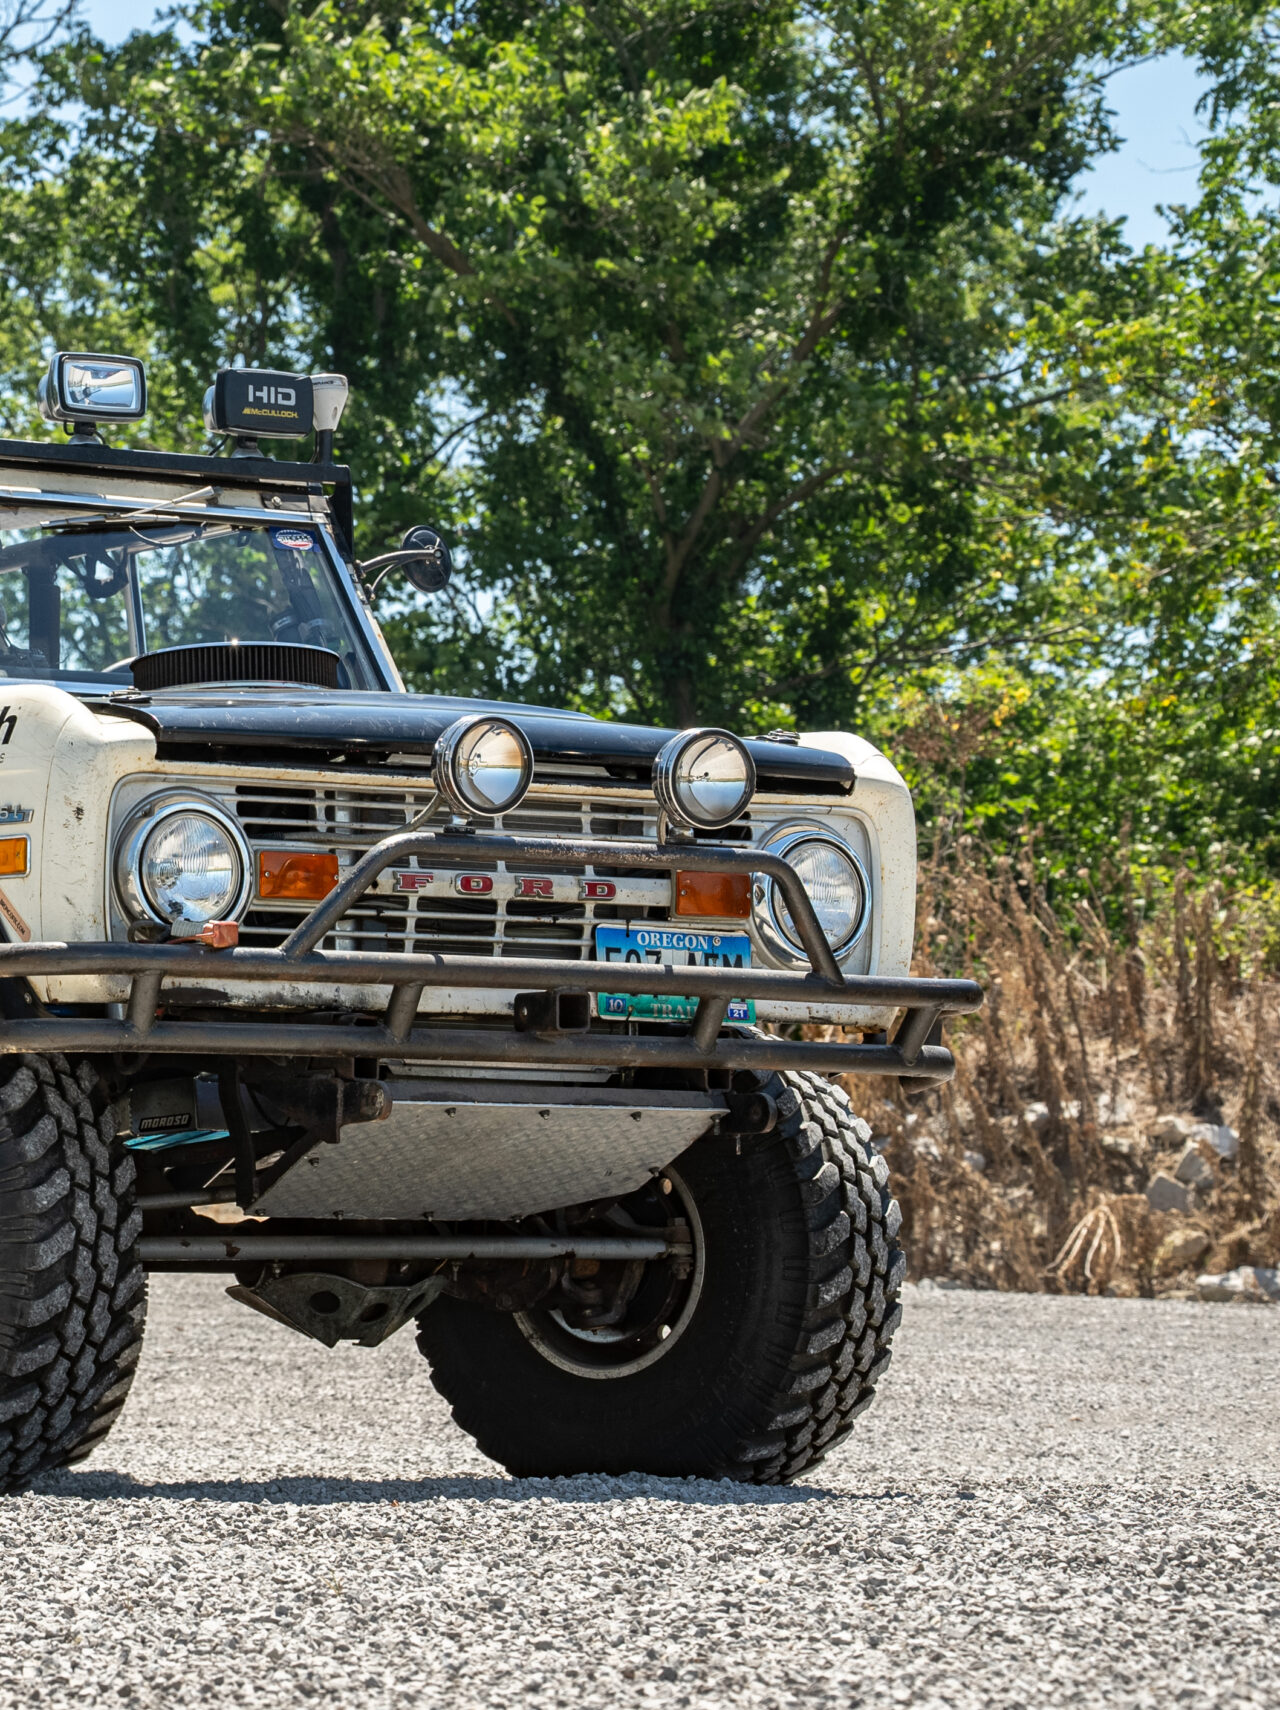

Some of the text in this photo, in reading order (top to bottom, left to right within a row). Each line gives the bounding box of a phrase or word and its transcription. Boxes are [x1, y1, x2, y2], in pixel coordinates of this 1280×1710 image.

[248, 384, 297, 406] HID
[393, 870, 617, 900] FORD
[636, 931, 709, 950] OREGON
[608, 998, 624, 1013] 10
[732, 1009, 744, 1018] 21
[140, 1114, 190, 1130] MOROSO
